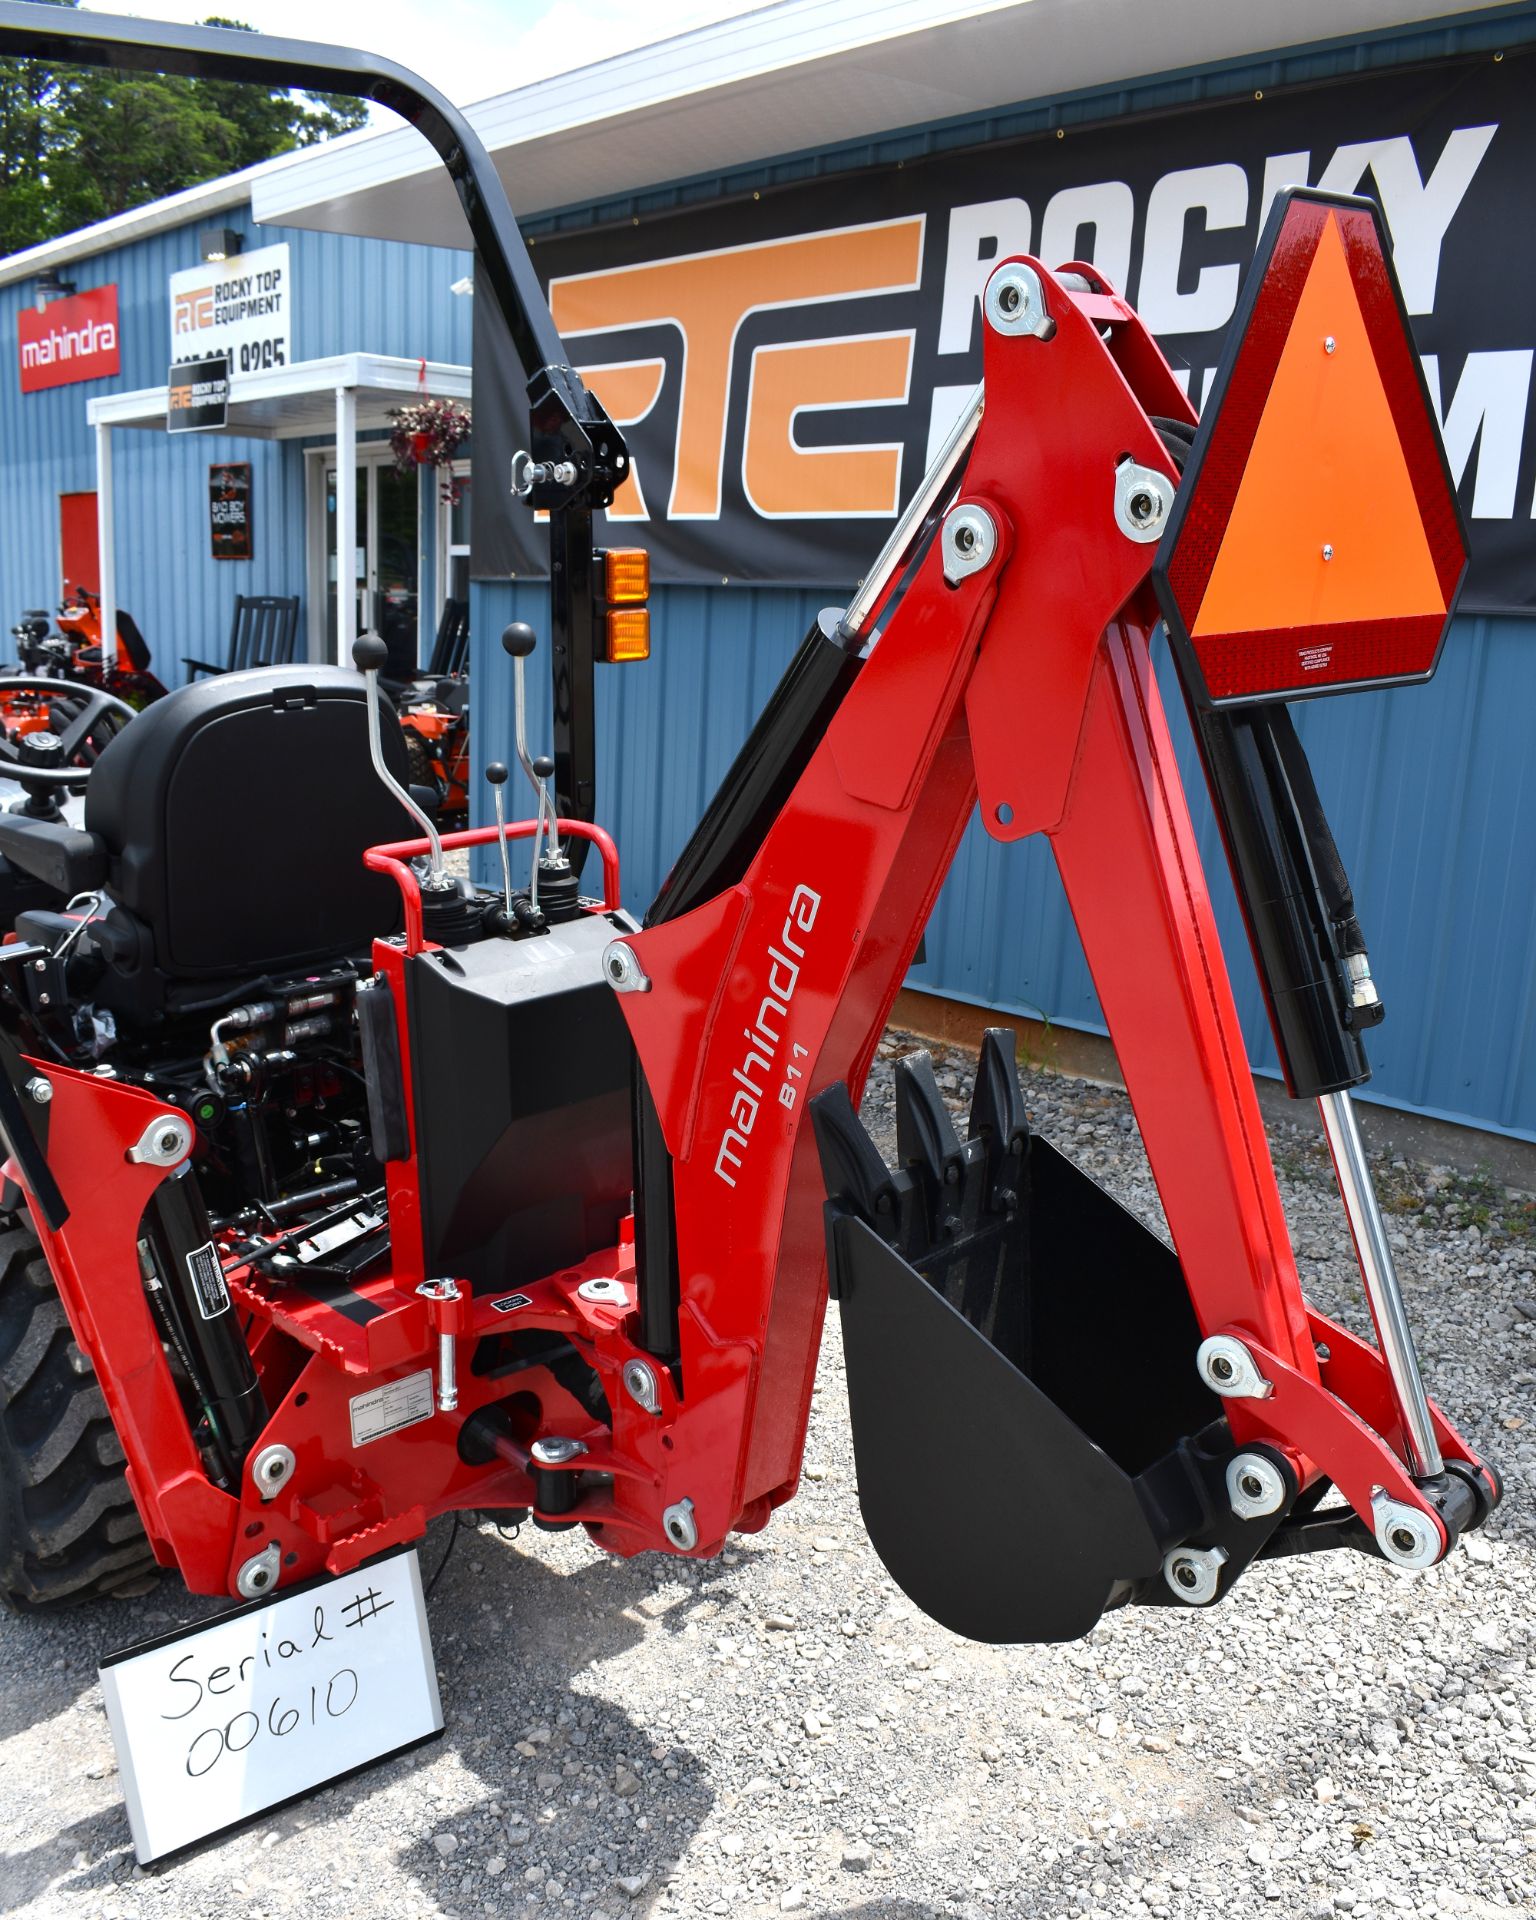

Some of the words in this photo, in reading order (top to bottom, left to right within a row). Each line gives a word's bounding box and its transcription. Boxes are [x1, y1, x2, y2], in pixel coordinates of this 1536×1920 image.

[175, 286, 213, 335] RTE
[215, 275, 253, 303] ROCKY
[256, 269, 281, 293] TOP
[215, 294, 282, 325] EQUIPMENT
[22, 319, 116, 369] mahindra
[212, 501, 228, 513] BAD
[229, 501, 244, 512] BOY
[212, 512, 245, 524] MOWERS
[714, 884, 821, 1188] mahindra
[778, 1042, 808, 1111] B11
[353, 1398, 384, 1413] mahindra
[161, 1606, 334, 1720] Serial
[341, 1588, 394, 1627] #
[187, 1669, 358, 1777] 00610
